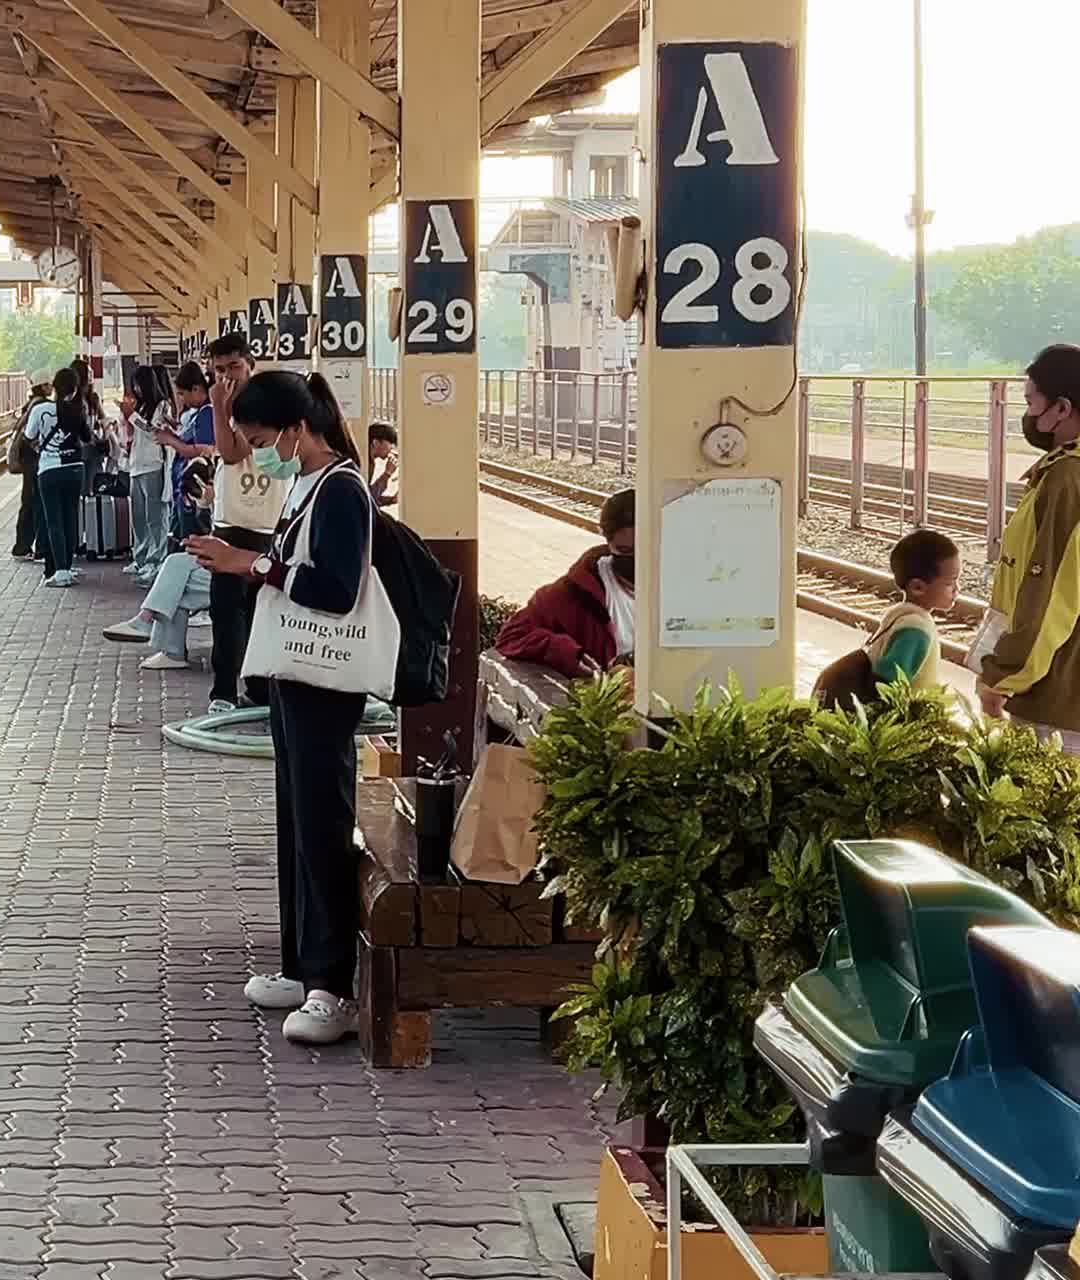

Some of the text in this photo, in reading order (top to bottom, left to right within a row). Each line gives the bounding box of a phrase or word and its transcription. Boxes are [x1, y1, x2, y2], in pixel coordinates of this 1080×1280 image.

[673, 52, 780, 167] A
[413, 204, 468, 263] A
[325, 257, 362, 297] A
[661, 236, 792, 323] 28
[253, 300, 275, 325] A
[281, 285, 309, 315] A
[408, 298, 474, 343] 29
[279, 332, 311, 356] 31
[322, 321, 365, 351] 30
[240, 472, 271, 496] 99
[334, 624, 367, 639] wild
[284, 640, 352, 662] and free
